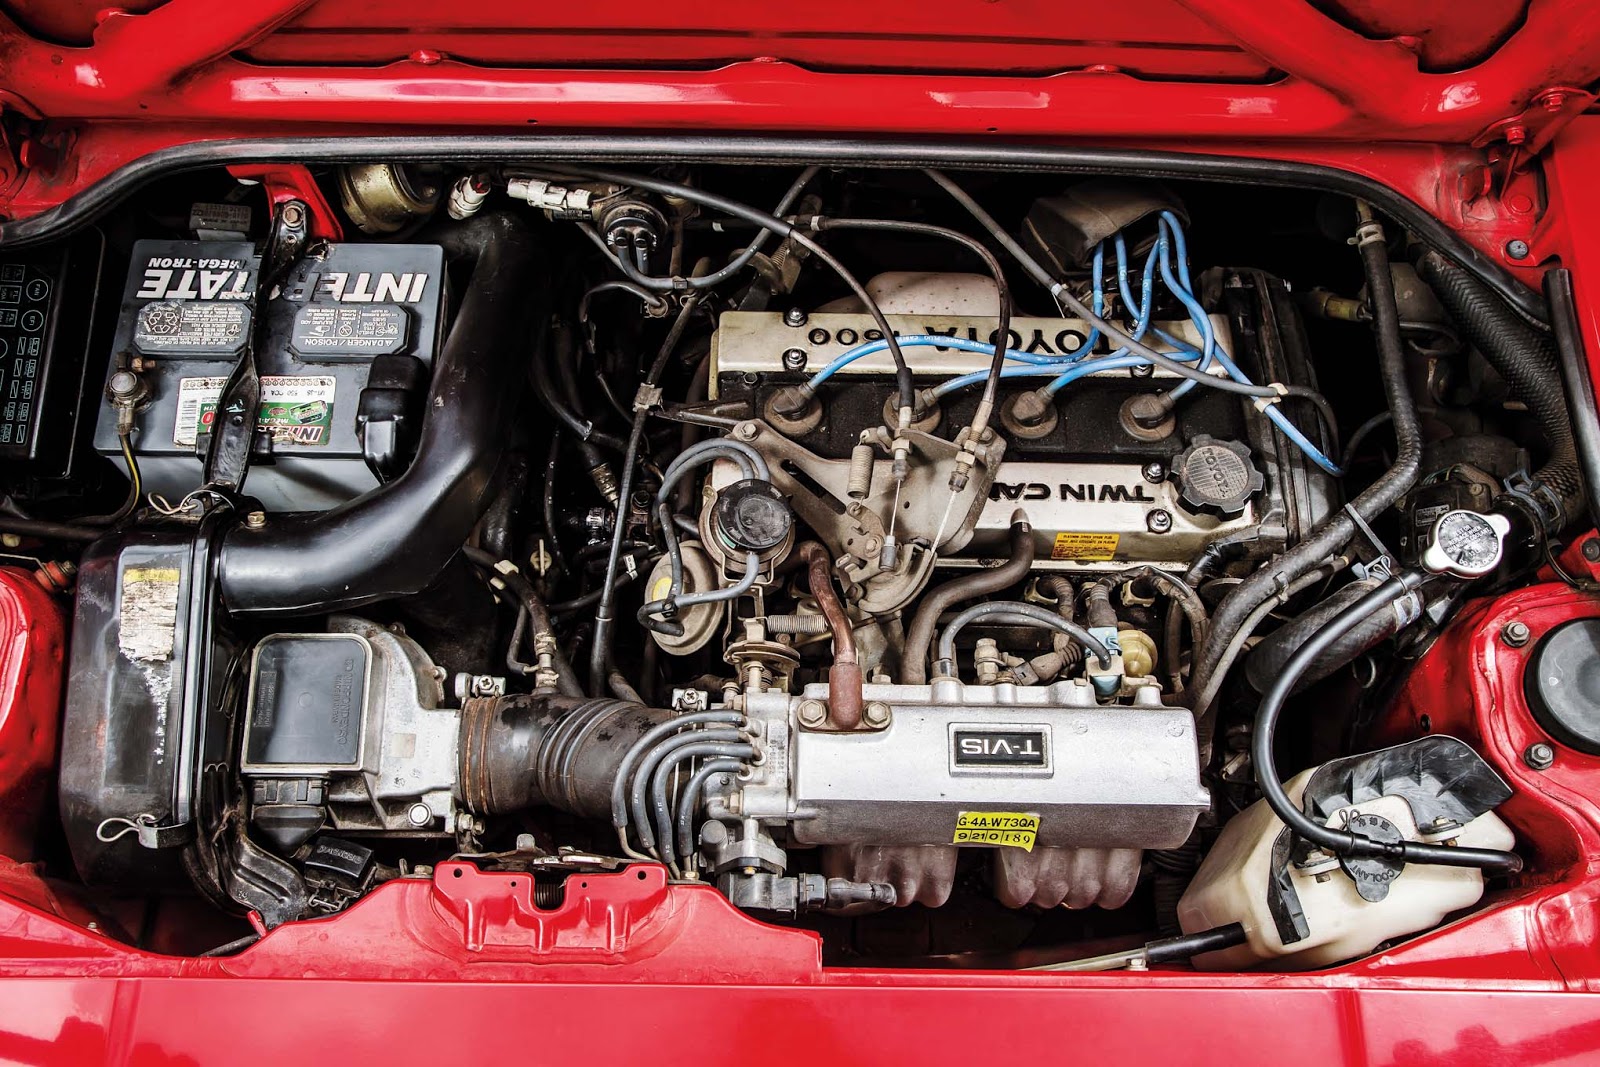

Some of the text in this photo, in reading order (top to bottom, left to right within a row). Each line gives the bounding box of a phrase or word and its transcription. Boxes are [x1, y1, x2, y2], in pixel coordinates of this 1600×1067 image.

[149, 257, 241, 270] MEGA-TRON
[34, 283, 42, 296] FAN
[136, 269, 429, 304] INTERTATE
[1060, 484, 1154, 504] TWIN
[1440, 512, 1465, 528] WARNING
[960, 738, 1040, 756] T-VIS
[1350, 864, 1394, 882] COOLANT
